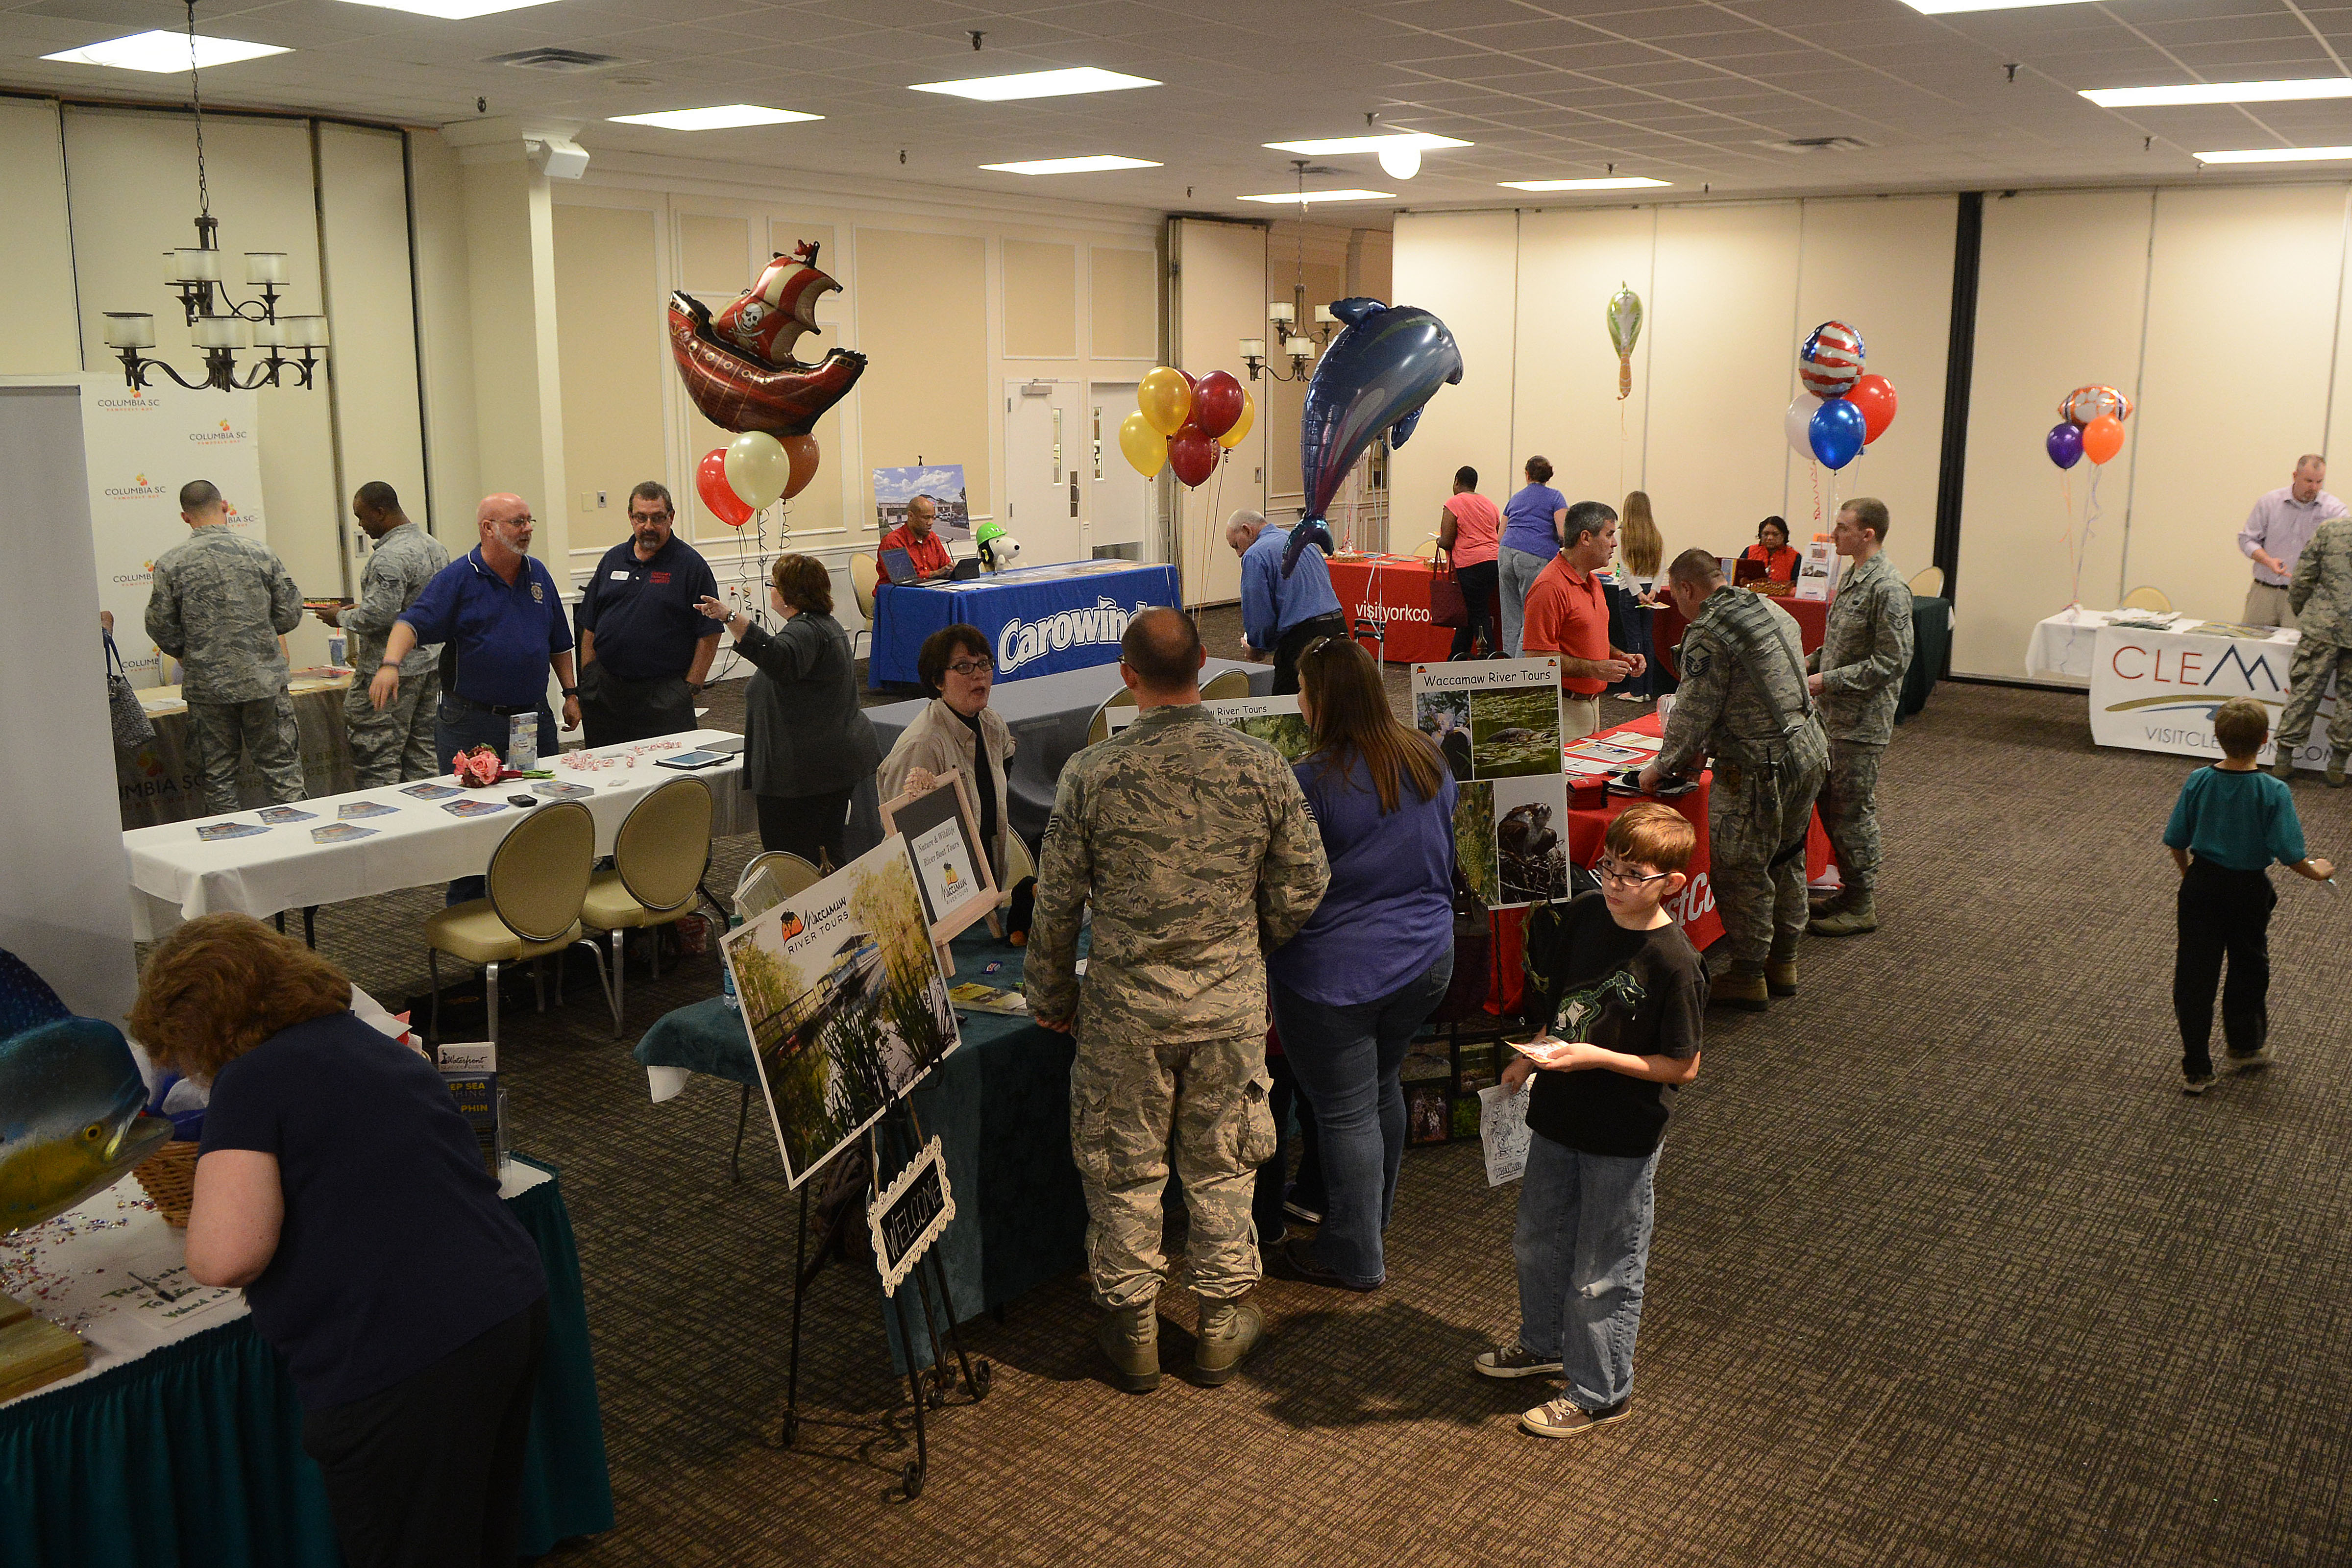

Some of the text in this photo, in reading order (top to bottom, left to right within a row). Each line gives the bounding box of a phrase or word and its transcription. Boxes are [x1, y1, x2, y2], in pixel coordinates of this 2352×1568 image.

[189, 432, 234, 441] COLUMBIA
[105, 487, 153, 495] COLUMBIA
[113, 573, 153, 583] COLUMB
[1355, 601, 1433, 623] visityorkco
[1423, 670, 1551, 686] Waccamaw River Tours
[2113, 643, 2290, 694] CLEM
[1217, 707, 1240, 716] River
[1242, 705, 1267, 714] Tours
[120, 778, 178, 800] MBIA
[917, 825, 956, 853] Nature & Wildlife
[923, 841, 960, 867] River Boat Tours
[787, 911, 849, 955] RIVER TOURS
[447, 1054, 488, 1068] Waterfront
[461, 1104, 488, 1112] PHIN
[882, 1172, 942, 1261] WELCOME
